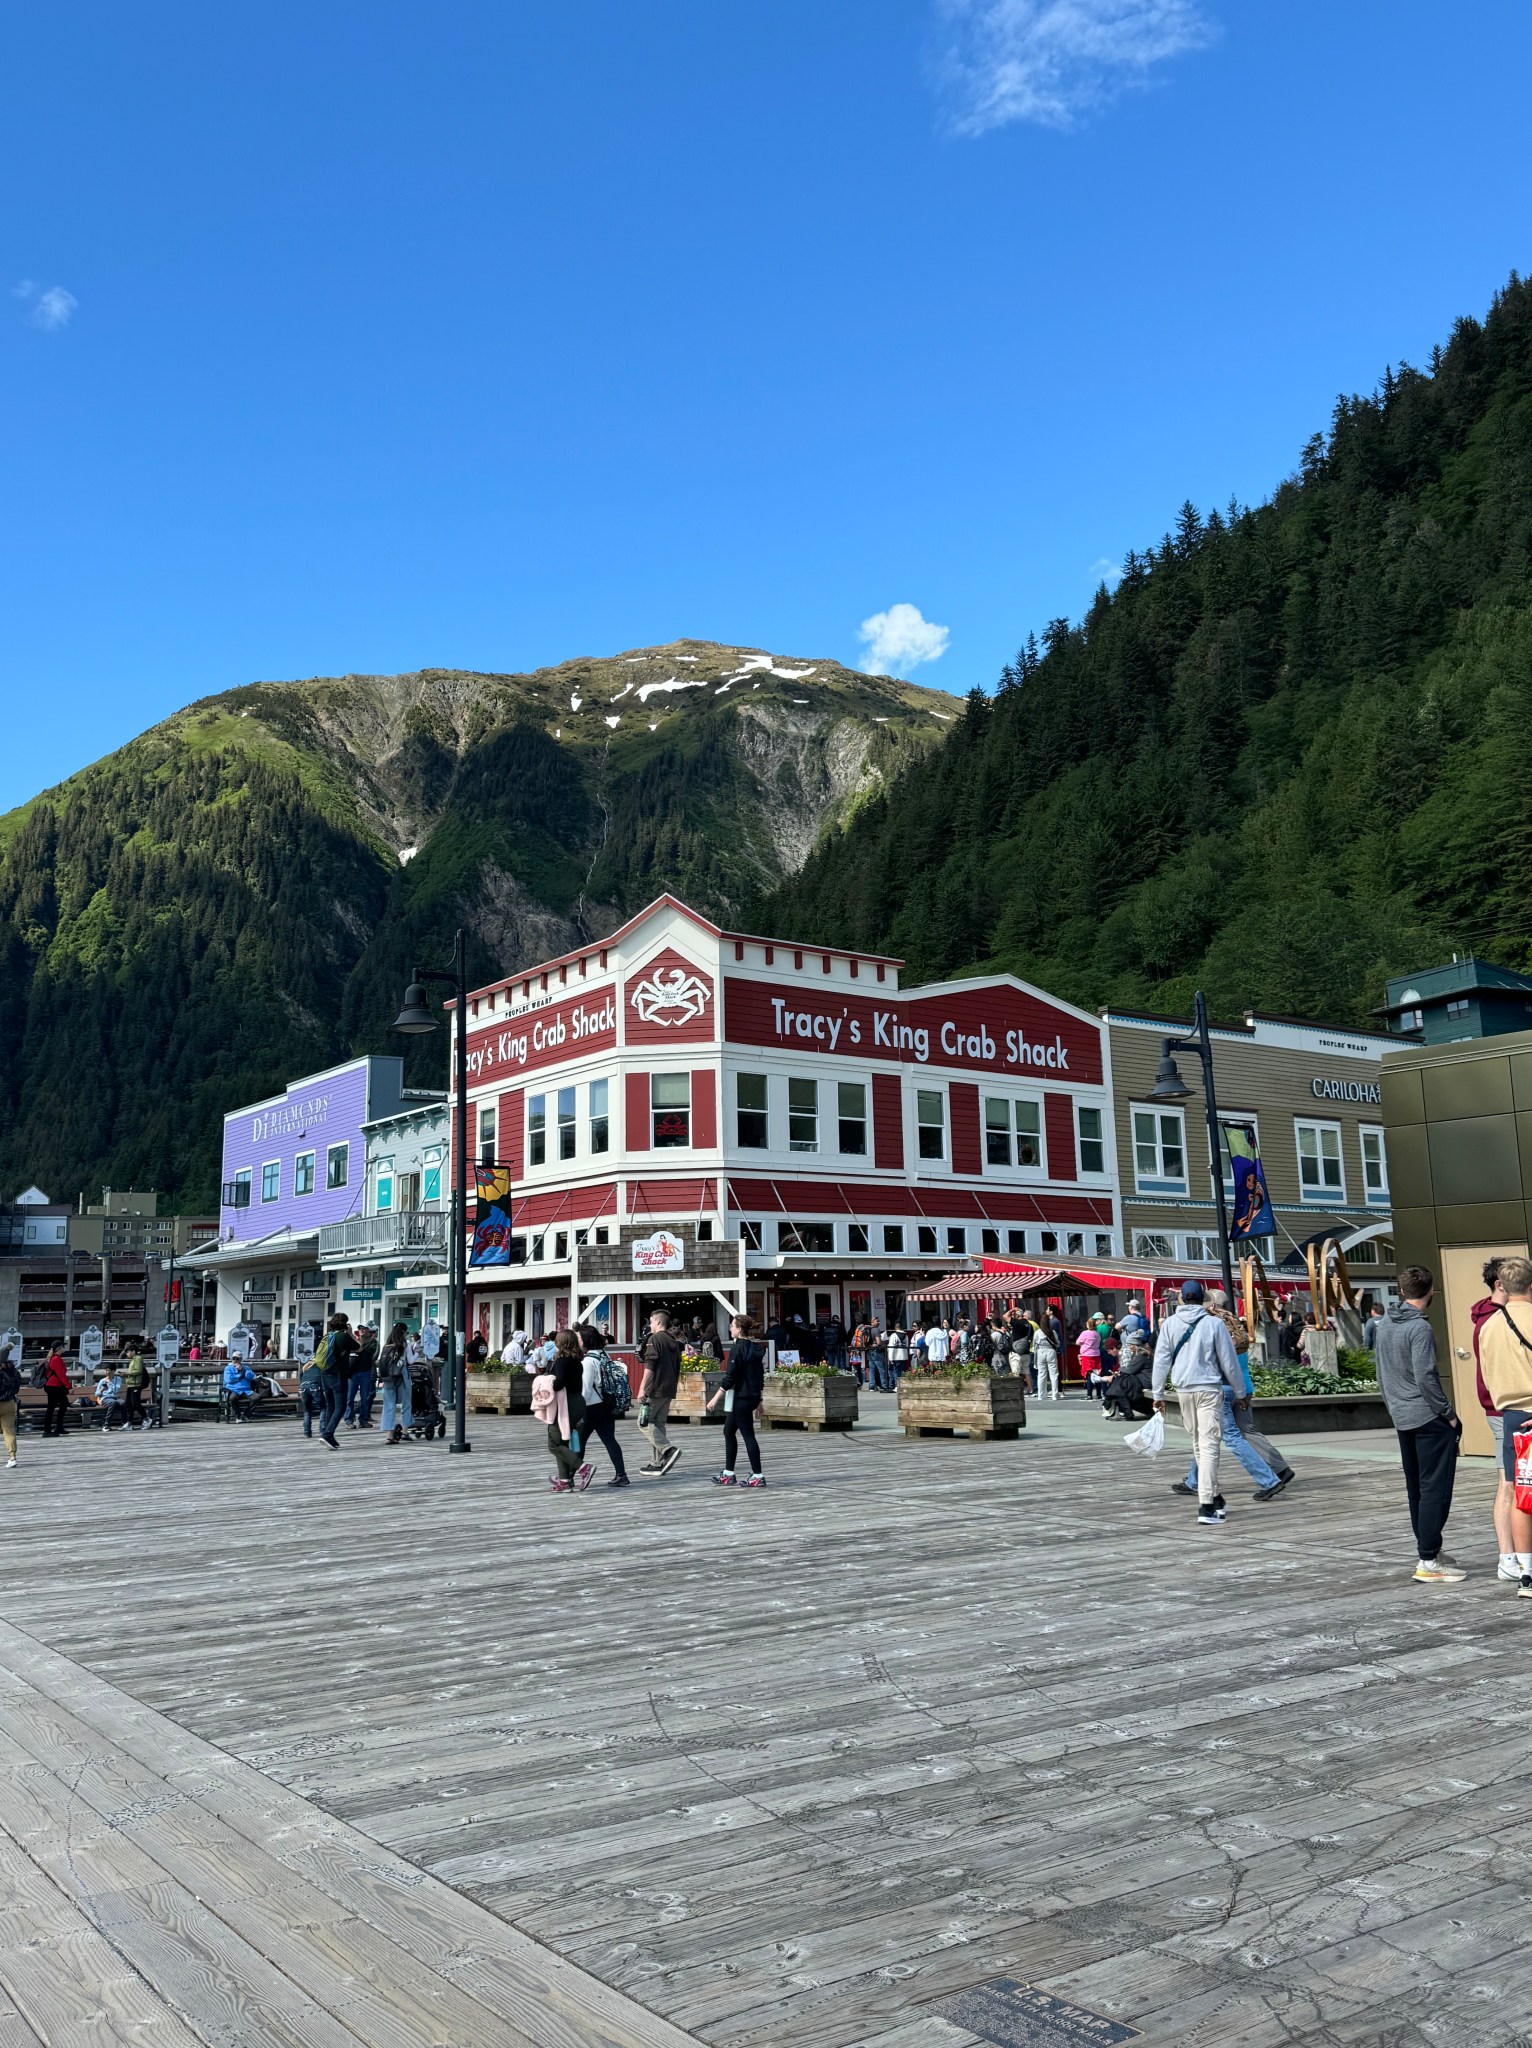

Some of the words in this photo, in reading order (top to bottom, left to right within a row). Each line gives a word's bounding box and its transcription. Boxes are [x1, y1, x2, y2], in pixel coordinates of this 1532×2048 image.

[531, 996, 553, 1009] WHARF
[499, 1031, 528, 1064] King
[533, 1013, 566, 1051] Crab
[572, 997, 616, 1040] Shack
[771, 997, 861, 1051] Tracy's
[873, 1011, 929, 1062] King
[941, 1021, 996, 1060] Crab
[1006, 1029, 1069, 1070] Shack
[1346, 1043, 1368, 1052] WHARF
[1312, 1077, 1379, 1104] CARILOHA
[271, 1096, 329, 1126] DIAMONDS
[634, 1251, 654, 1260] King
[654, 1250, 674, 1259] Crab
[641, 1258, 668, 1266] Shack
[1010, 1998, 1042, 2014] WITH
[1077, 2028, 1114, 2046] NAILS
[1012, 1987, 1053, 2008] U.S.
[1056, 2005, 1111, 2030] MAP
